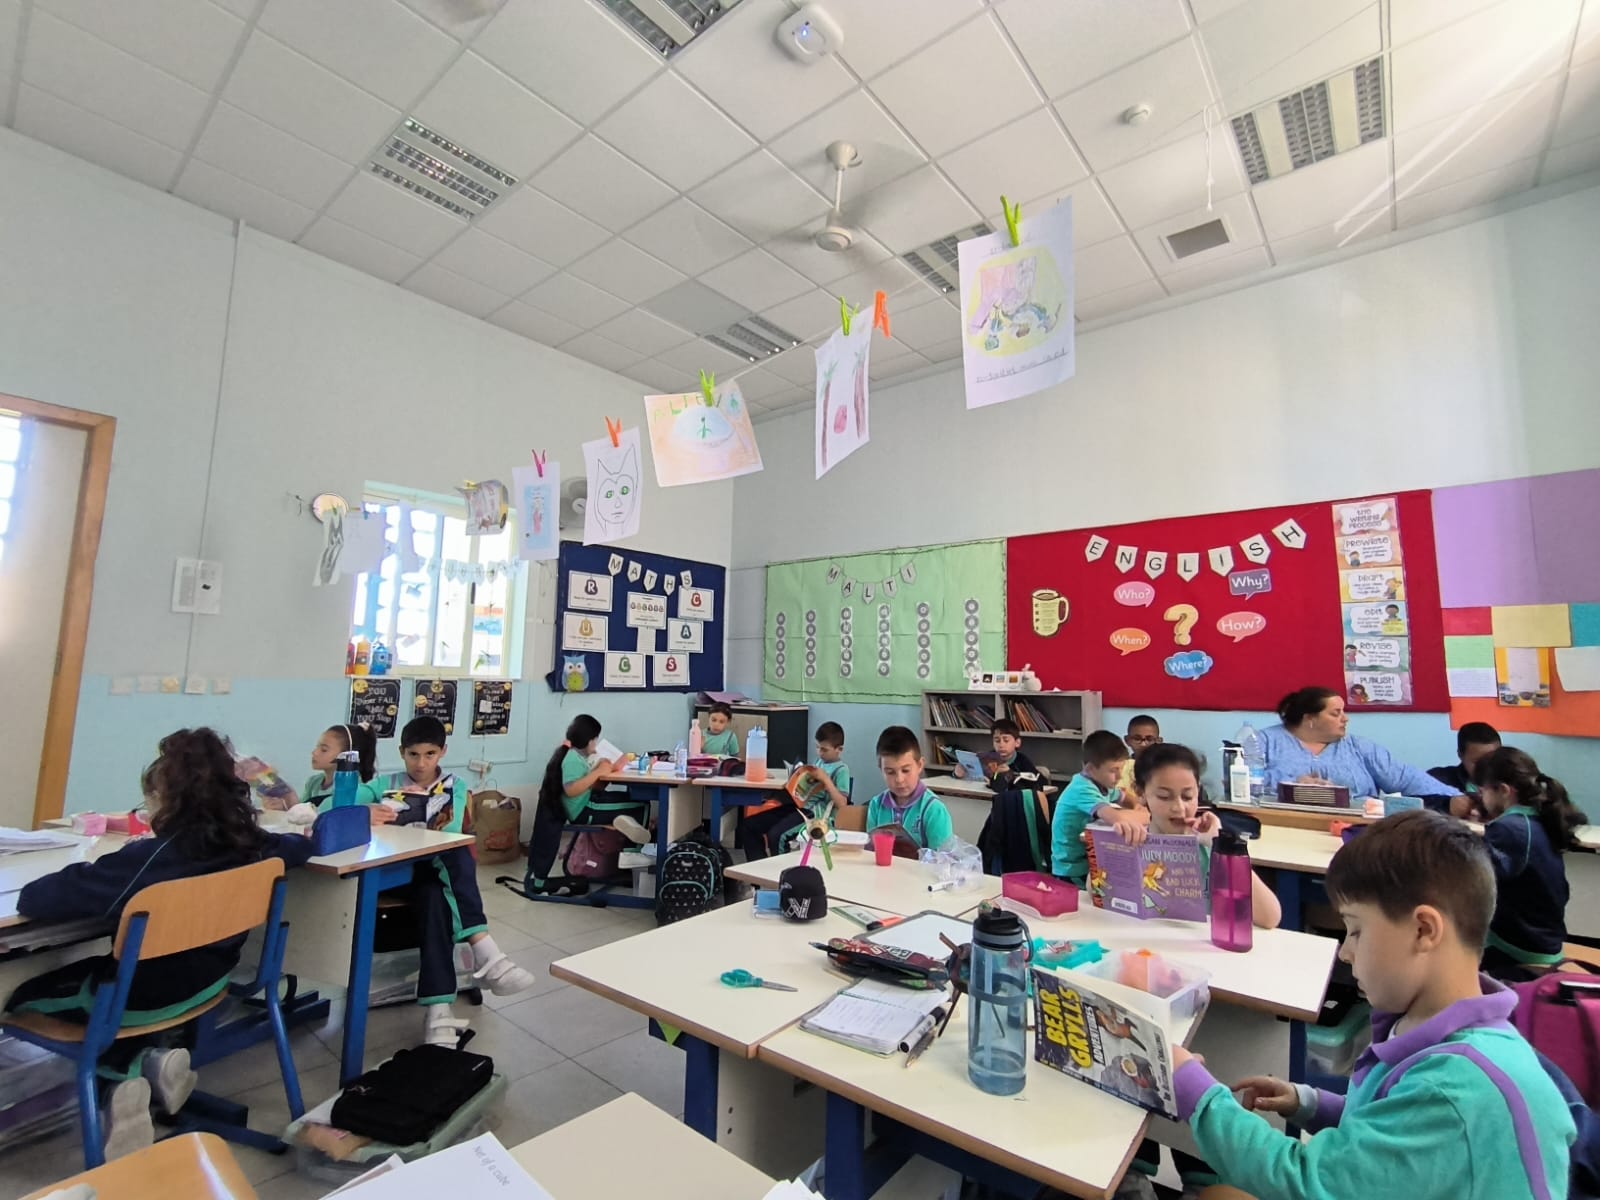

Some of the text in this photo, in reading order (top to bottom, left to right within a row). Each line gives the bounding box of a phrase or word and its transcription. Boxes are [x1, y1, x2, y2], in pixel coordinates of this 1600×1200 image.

[1089, 526, 1300, 573] ENGLISH
[610, 558, 690, 588] MATHS
[828, 568, 912, 598] MALTI
[1231, 574, 1268, 589] Why?
[1118, 588, 1150, 600] Who?
[1220, 616, 1262, 632] How?
[1112, 634, 1148, 645] When?
[1168, 656, 1208, 672] Where?
[1142, 850, 1196, 864] JUDY MOODY
[1174, 888, 1202, 898] CHARM
[1040, 989, 1067, 1046] BEAR
[1058, 985, 1092, 1068] GRYLLS
[1085, 1006, 1104, 1063] ADVENTURES
